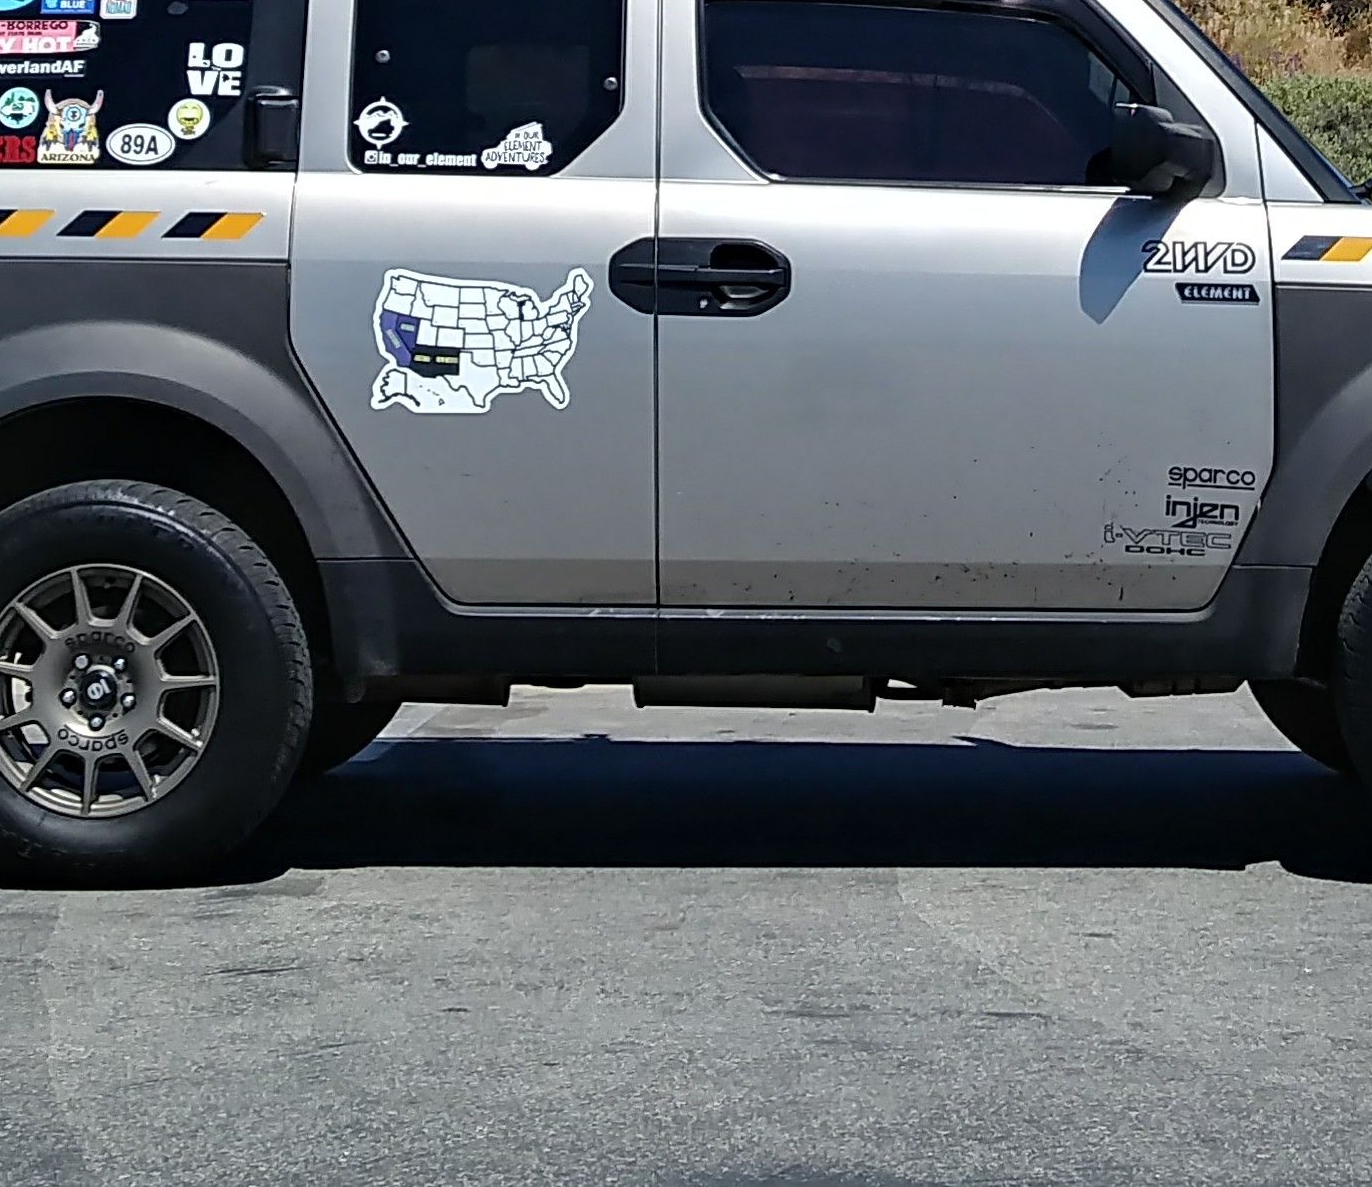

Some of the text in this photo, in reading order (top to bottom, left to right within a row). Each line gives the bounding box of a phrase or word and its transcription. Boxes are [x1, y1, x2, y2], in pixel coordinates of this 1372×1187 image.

[60, 1, 86, 9] BLUE
[22, 35, 73, 54] HOT
[523, 131, 540, 140] OUR
[120, 134, 159, 155] 89A
[504, 140, 543, 152] ELEMENT
[40, 153, 96, 162] ARIZONA
[485, 152, 546, 164] ADVENTURES
[1141, 239, 1257, 274] 2WD
[1183, 285, 1252, 300] ELEMENT
[1168, 466, 1256, 490] sparco
[1165, 495, 1240, 528] injen
[1124, 545, 1206, 556] DOHC
[64, 630, 136, 653] sparco
